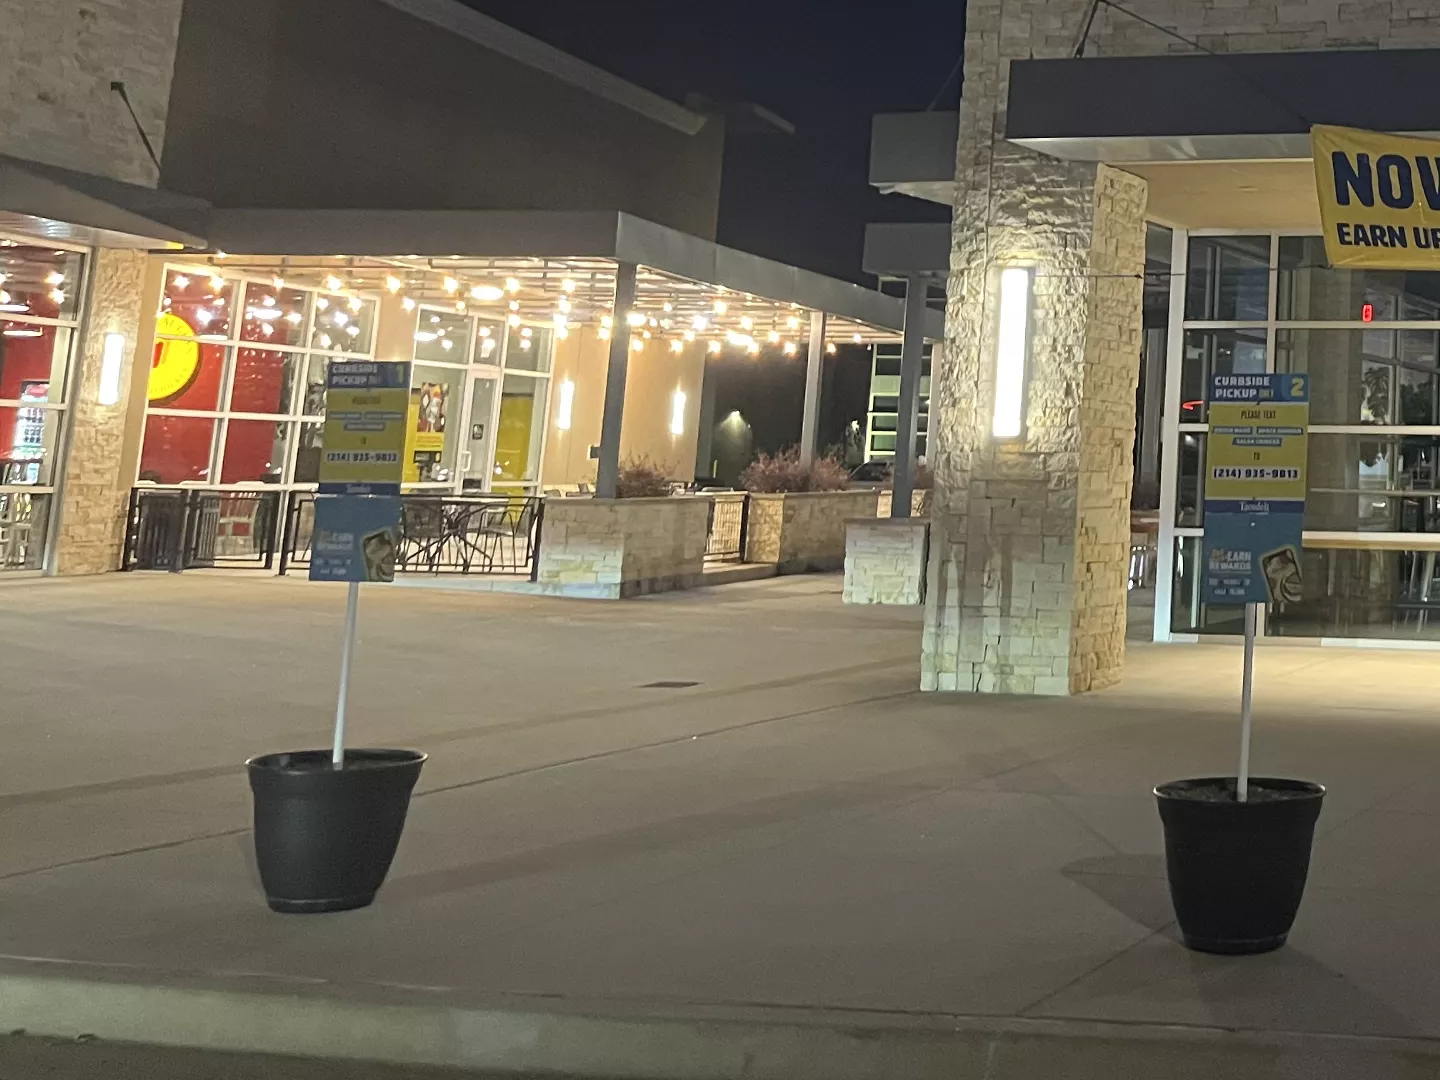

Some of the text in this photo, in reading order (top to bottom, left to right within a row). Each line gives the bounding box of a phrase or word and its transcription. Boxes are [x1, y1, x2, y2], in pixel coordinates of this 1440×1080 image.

[1336, 222, 1408, 249] EARN
[1214, 376, 1270, 387] CURBSIDE
[1290, 377, 1304, 397] 2
[1215, 388, 1257, 398] PICKUP
[1240, 410, 1276, 420] PLEASE TEXT
[1213, 468, 1242, 479] (214)
